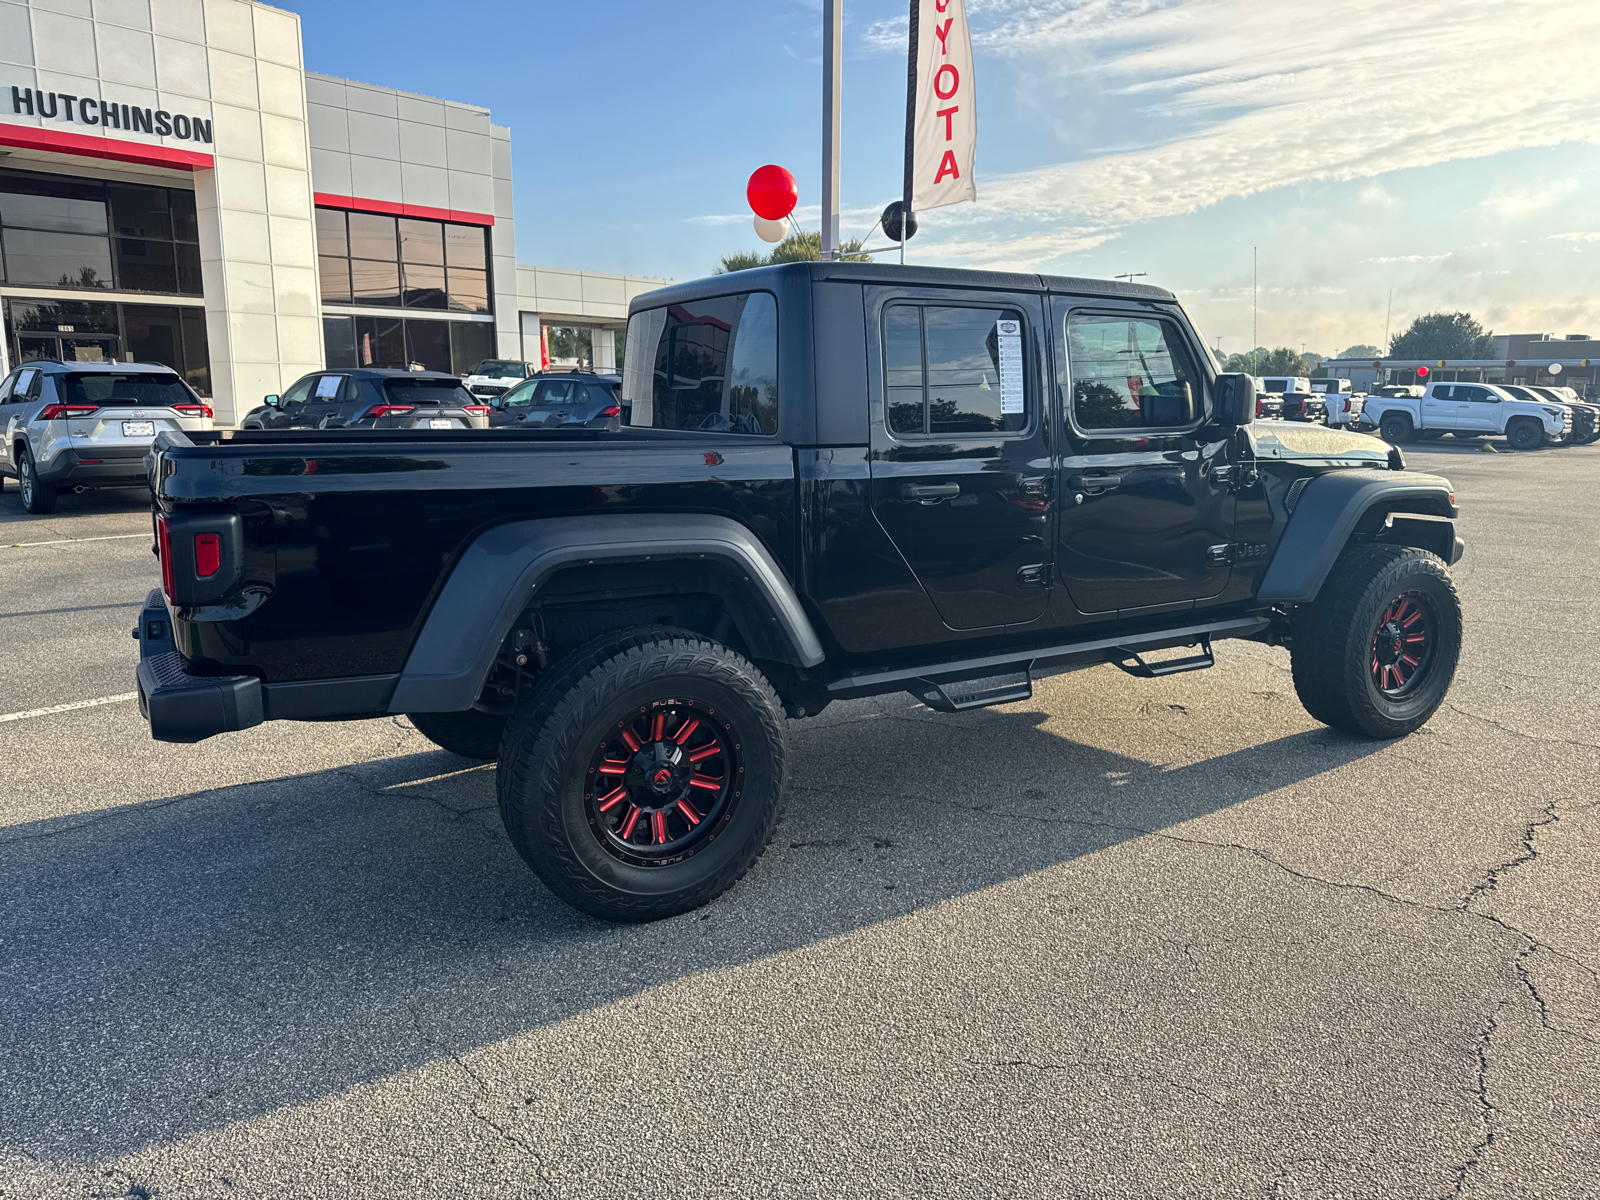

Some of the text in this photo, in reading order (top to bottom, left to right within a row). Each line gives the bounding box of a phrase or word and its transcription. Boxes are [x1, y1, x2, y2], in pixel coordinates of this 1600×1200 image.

[11, 85, 213, 144] HUTCHINSON
[1239, 542, 1268, 558] Jeep
[652, 698, 682, 708] FUEL
